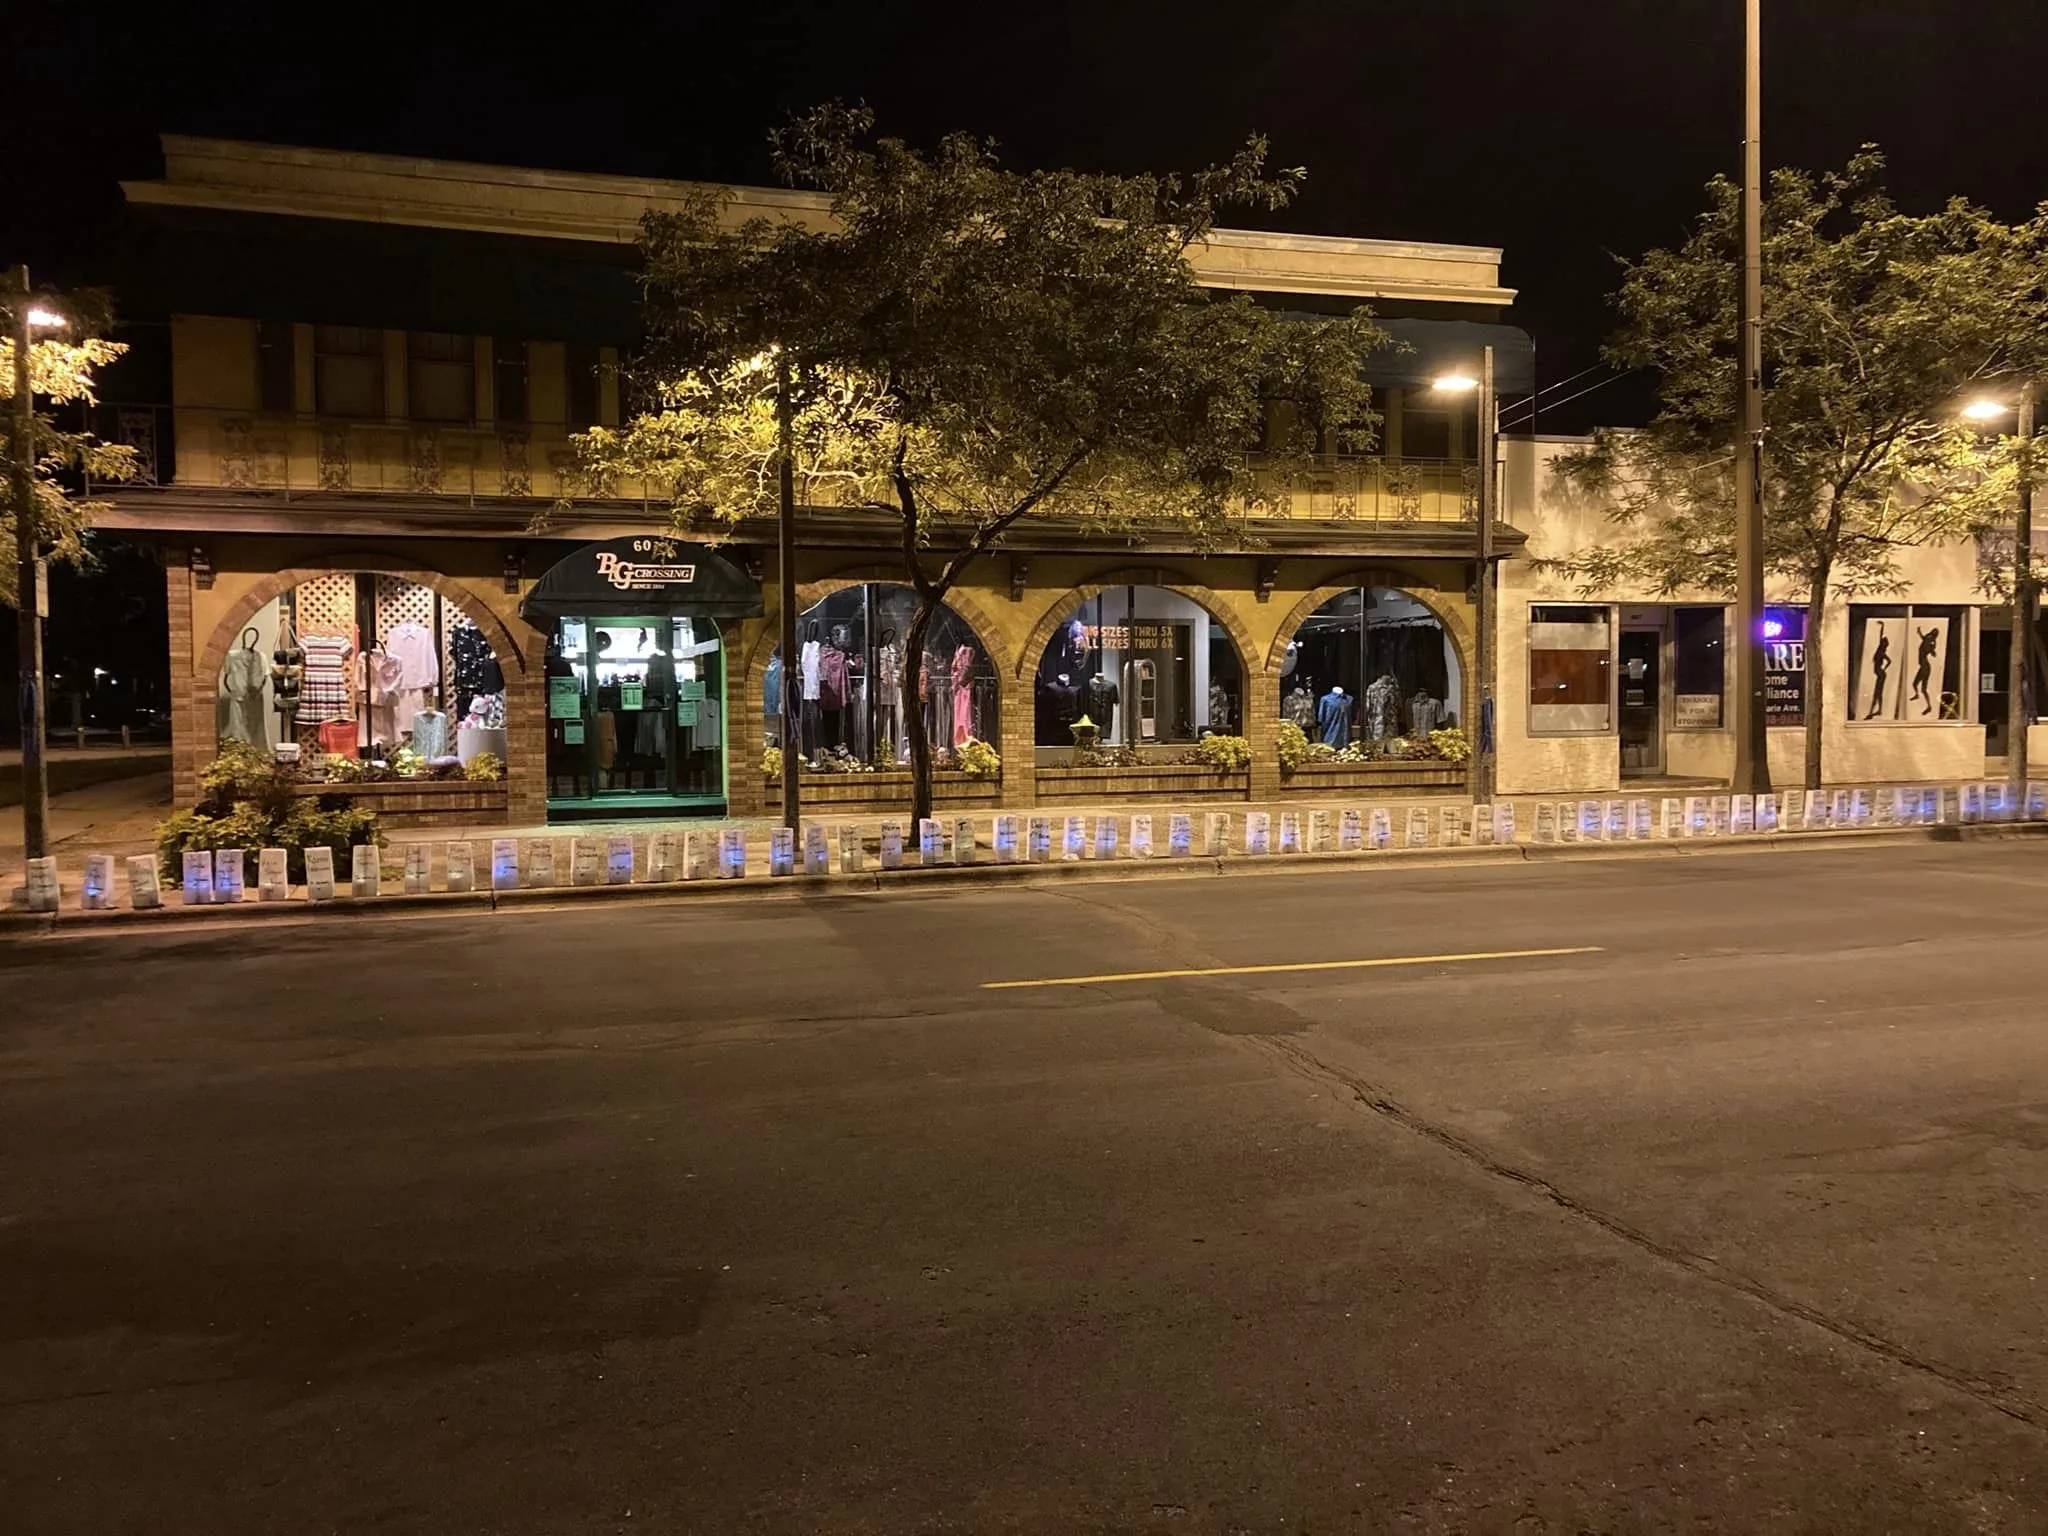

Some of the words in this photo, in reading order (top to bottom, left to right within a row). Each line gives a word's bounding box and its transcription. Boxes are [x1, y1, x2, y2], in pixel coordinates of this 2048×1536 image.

[634, 568, 690, 578] CROSSING
[1101, 626, 1129, 638] SIZES
[1134, 626, 1157, 637] THRU
[1160, 626, 1174, 637] 5X
[1101, 638, 1129, 649] SIZES
[1134, 638, 1158, 649] THRU
[1160, 638, 1174, 649] 6X
